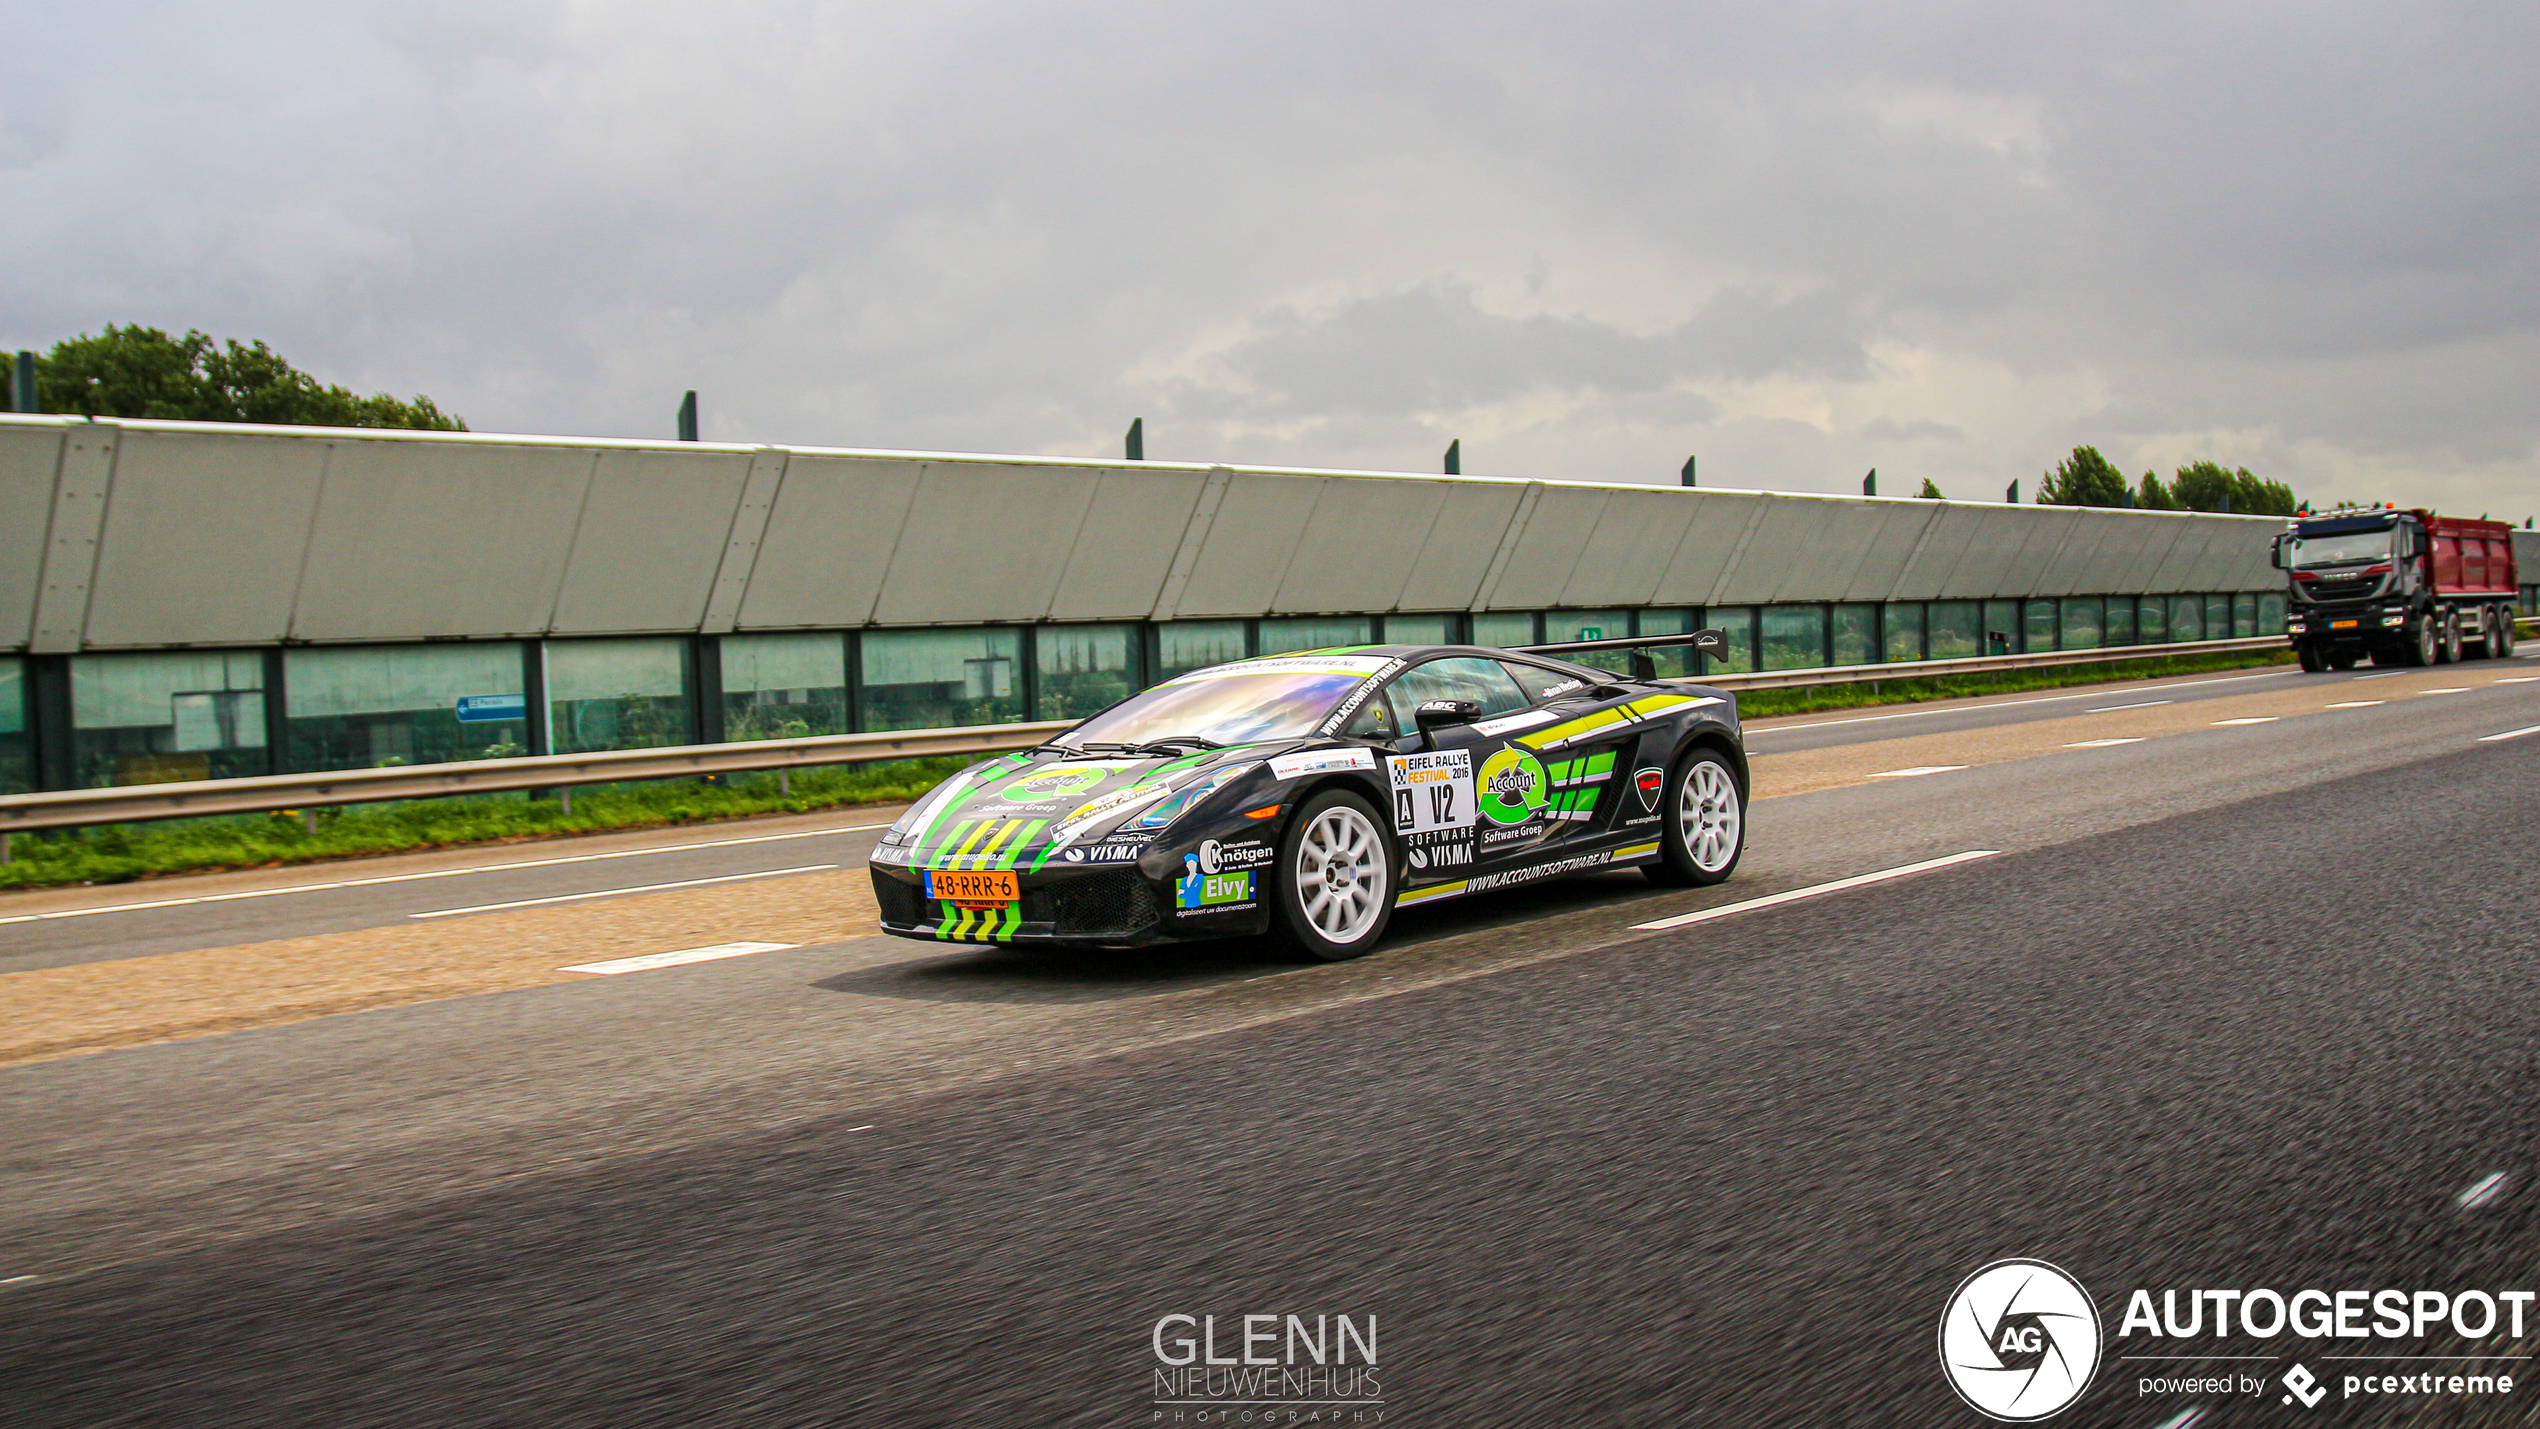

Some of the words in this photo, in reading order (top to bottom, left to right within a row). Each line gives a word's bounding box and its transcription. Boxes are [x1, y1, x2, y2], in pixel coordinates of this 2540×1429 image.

[1319, 656, 1408, 737] WWW.ACCOUNTSOFTWARE.NL
[1421, 702, 1457, 711] ABC
[1409, 756, 1434, 770] EIFEL
[1435, 753, 1468, 767] RALLYE
[1408, 769, 1450, 784] FESTIVAL
[1452, 767, 1469, 780] 2016
[1487, 771, 1536, 792] Account
[978, 804, 1024, 812] Software
[1025, 803, 1057, 813] Groep
[1400, 793, 1412, 821] A
[1429, 783, 1456, 824] V2
[1408, 826, 1474, 846] SOFTWARE
[1484, 828, 1519, 844] Software
[1520, 824, 1543, 838] Groep
[937, 852, 1009, 862] www.mugello.nl
[1090, 845, 1138, 861] VISMA
[1211, 846, 1273, 864] Knötgen
[1430, 843, 1474, 867] VISMA
[1467, 851, 1612, 893] WWW.ACCOUNTSOFTWARE.NL
[936, 876, 1012, 897] 48-RRR-6
[1206, 876, 1246, 900] Elvy
